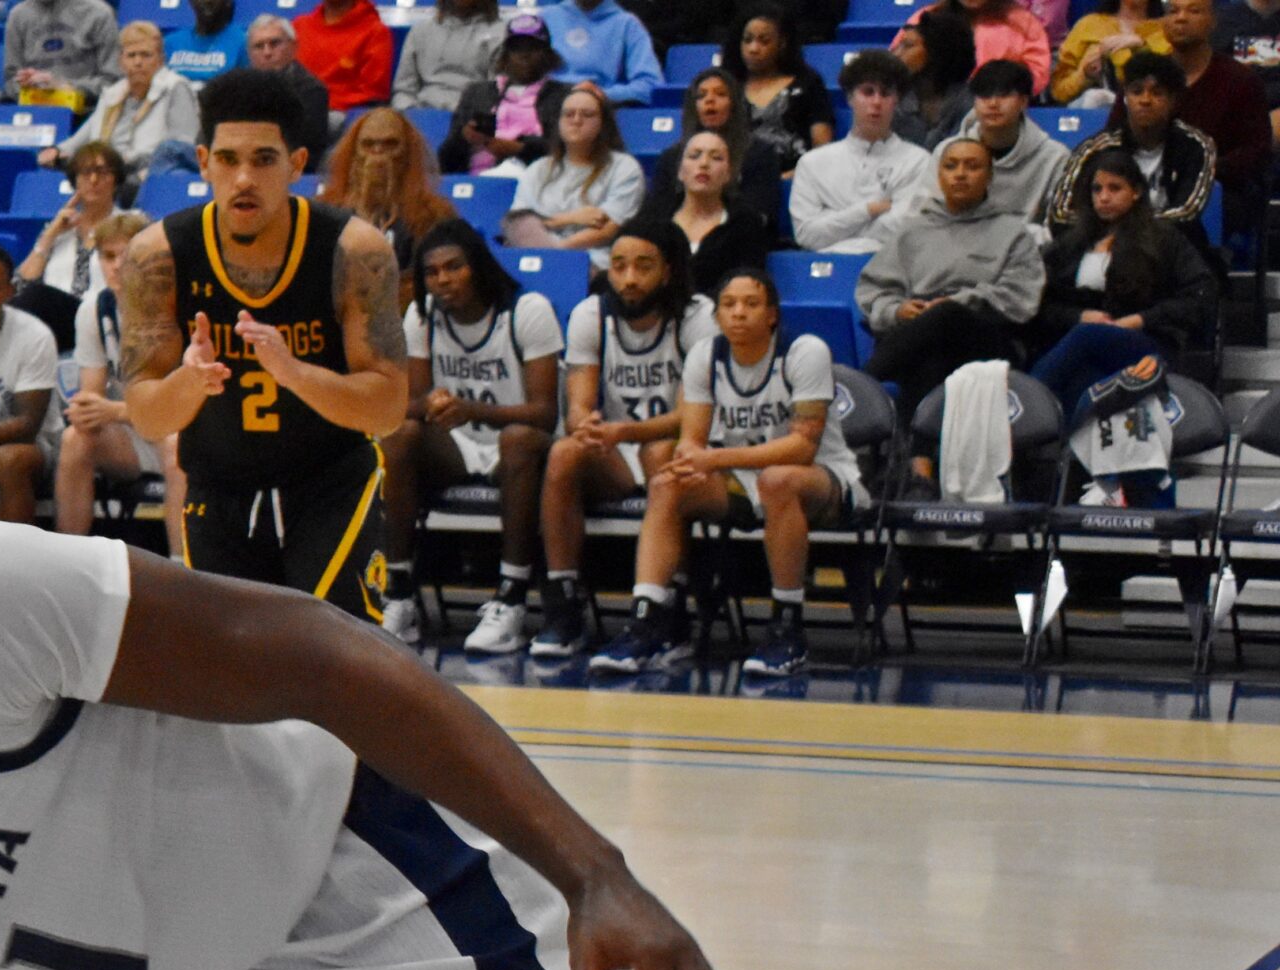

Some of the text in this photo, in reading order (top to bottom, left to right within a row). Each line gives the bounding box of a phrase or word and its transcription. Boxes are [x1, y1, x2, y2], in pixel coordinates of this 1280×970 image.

[239, 371, 280, 432] 2
[913, 509, 984, 524] JAGUARS
[1082, 513, 1155, 529] JAGUARS
